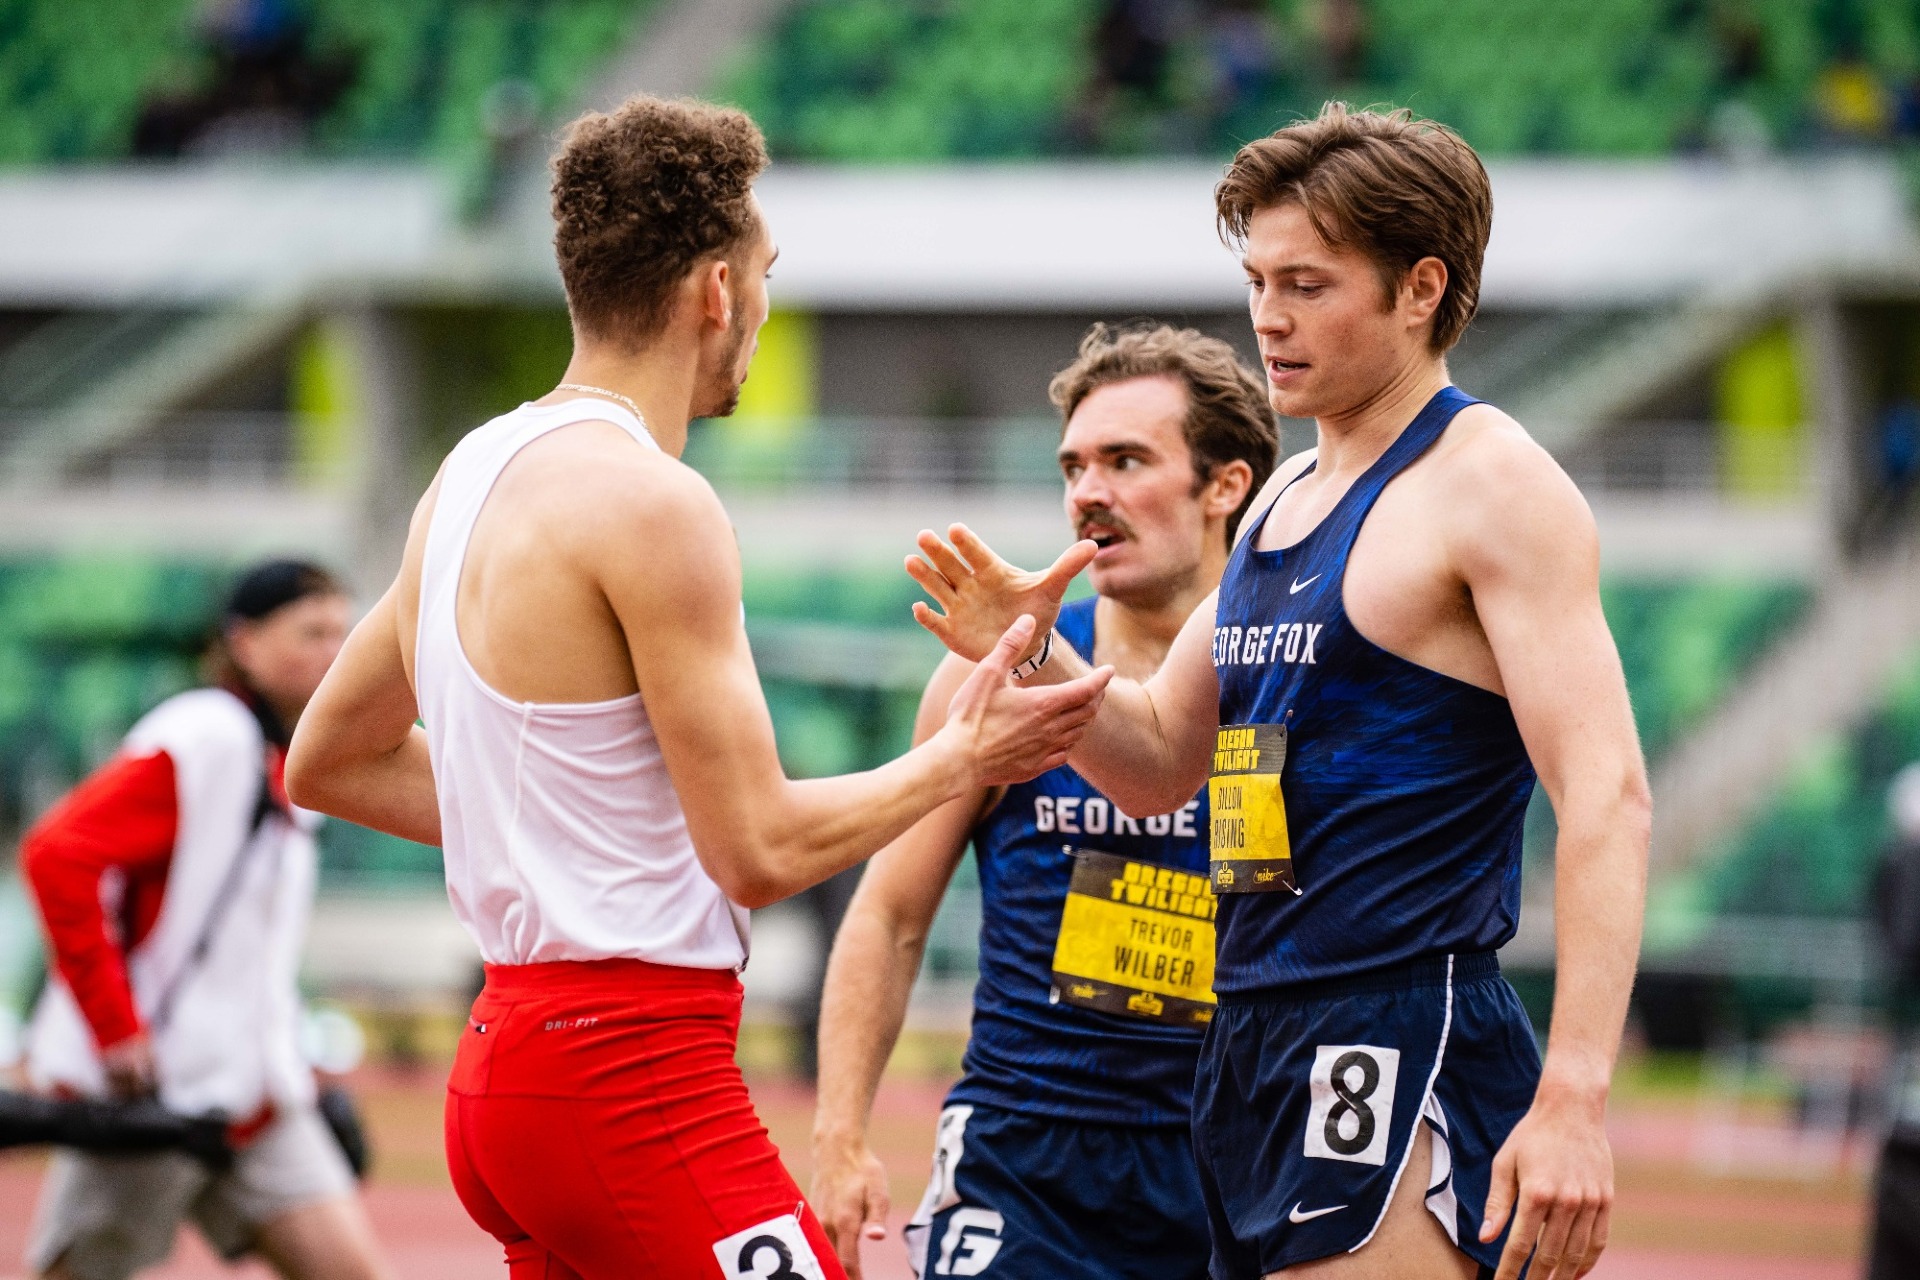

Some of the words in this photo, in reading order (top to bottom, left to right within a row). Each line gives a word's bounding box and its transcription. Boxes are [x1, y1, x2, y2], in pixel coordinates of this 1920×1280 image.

[1211, 625, 1274, 667] EORGE
[1270, 622, 1324, 664] FOX
[1213, 817, 1245, 849] RISING
[1129, 918, 1194, 953] TREVOR
[1114, 945, 1195, 988] WILBER
[544, 1016, 599, 1032] DRI-FIT
[1323, 1050, 1380, 1156] 8
